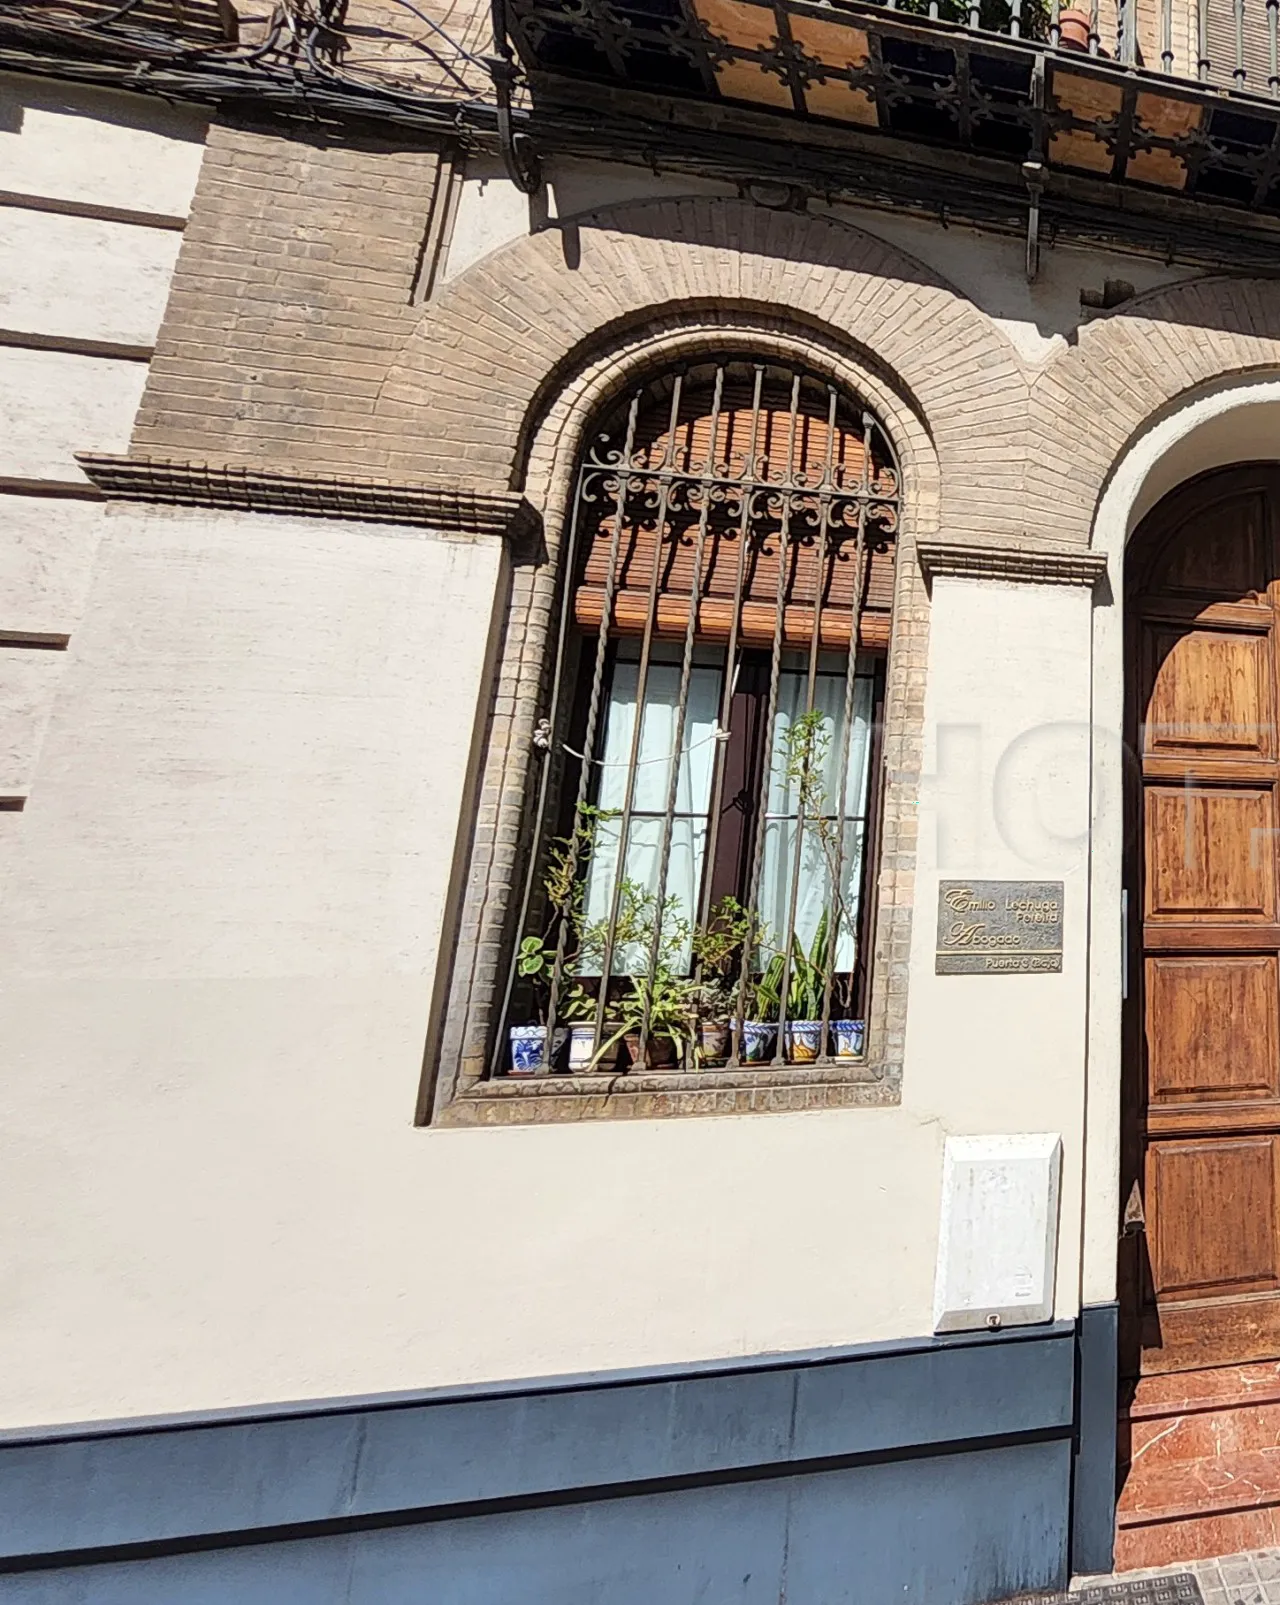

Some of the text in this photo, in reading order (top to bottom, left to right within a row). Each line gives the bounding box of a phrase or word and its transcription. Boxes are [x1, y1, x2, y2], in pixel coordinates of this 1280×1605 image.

[945, 888, 1058, 913] Emilio Lechuga
[1017, 912, 1059, 924] Pereira
[943, 921, 1021, 947] Abogado
[986, 958, 1020, 970] Puerta
